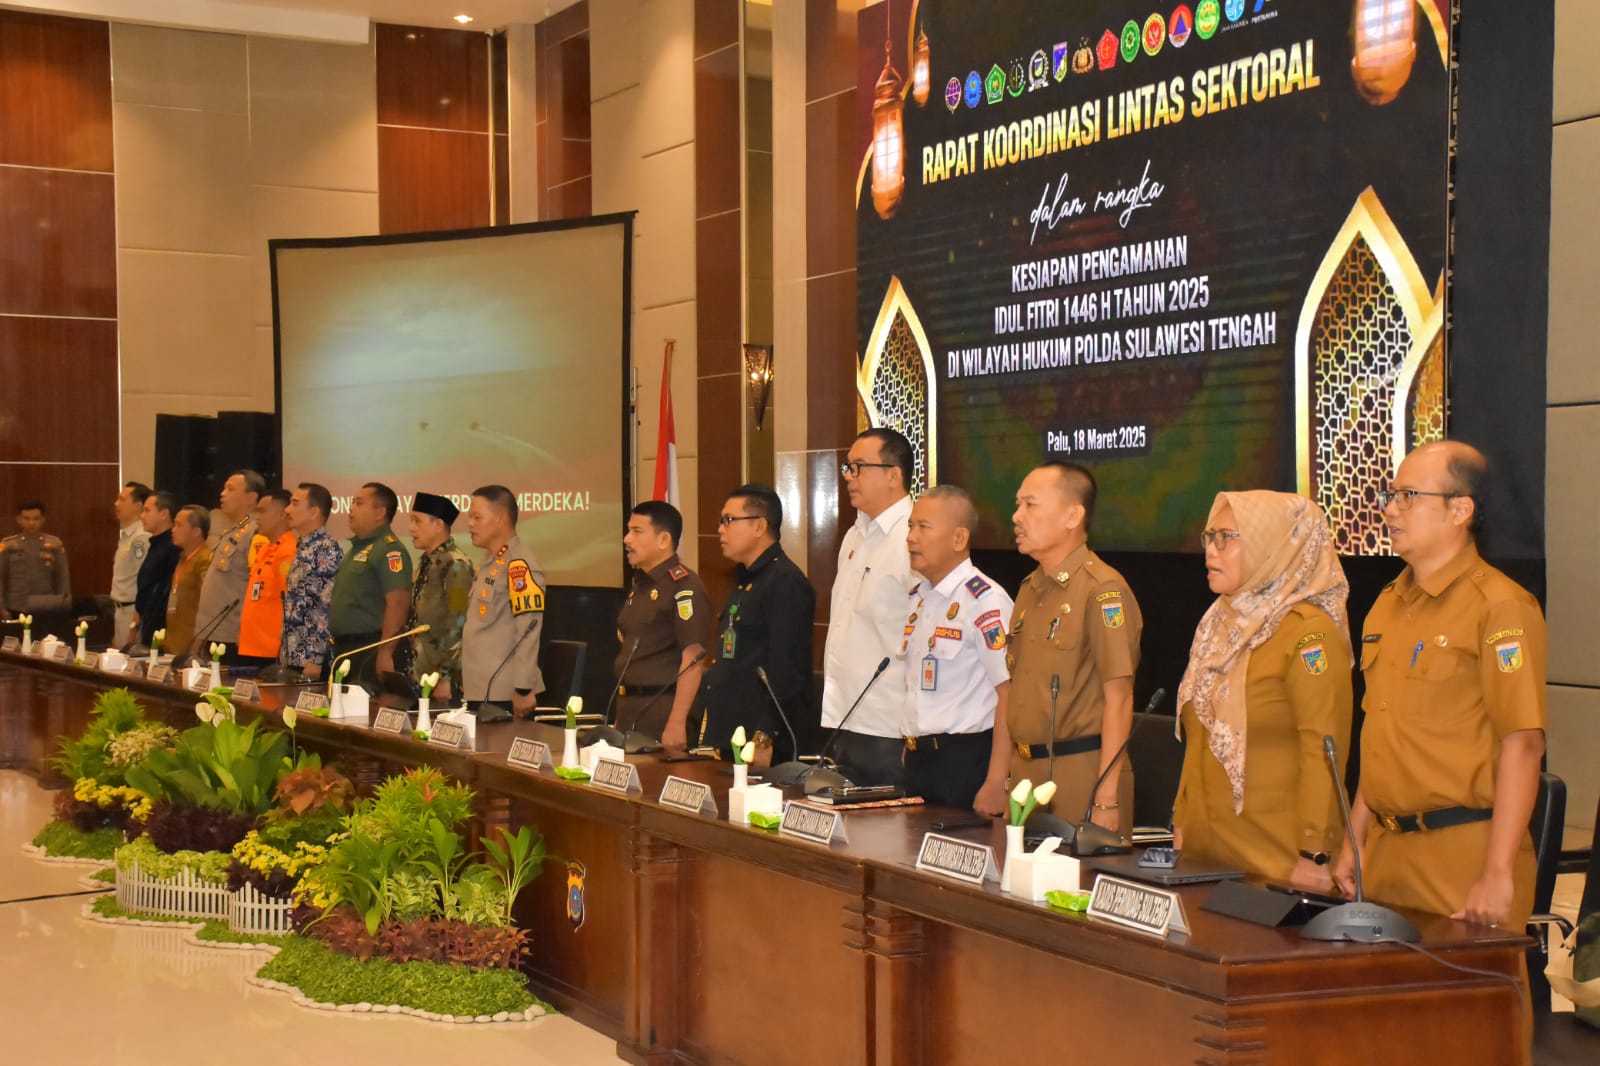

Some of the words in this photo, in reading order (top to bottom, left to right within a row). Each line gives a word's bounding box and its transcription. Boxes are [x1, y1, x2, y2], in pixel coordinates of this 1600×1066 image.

[922, 133, 979, 185] RAPAT
[983, 99, 1100, 170] KOORDINASI
[1108, 75, 1185, 135] LINTAS
[1191, 39, 1321, 118] SEKTORAL
[1030, 172, 1086, 246] dalam
[1094, 159, 1165, 228] rangka
[1012, 254, 1078, 293] KESIAPAN
[1082, 235, 1188, 282] PENGAMANAN
[994, 303, 1024, 335] IDUL
[1027, 298, 1059, 330] FITRI
[1063, 292, 1097, 327] 1446
[1101, 290, 1111, 320] H
[1113, 280, 1165, 318] TAHUN
[1168, 275, 1209, 312] 2025
[947, 350, 960, 378] DI
[963, 343, 1019, 377] WILAYAH
[1023, 337, 1071, 371] HUKUM
[1074, 331, 1122, 366] POLDA
[1125, 320, 1205, 360] SULAWESI
[1209, 311, 1276, 350] TENGAH
[1047, 430, 1071, 455] Palu,
[1073, 429, 1085, 450] 18
[1087, 427, 1117, 450] Maret
[1119, 425, 1146, 448] 2025
[1349, 910, 1386, 919] BOSCH
